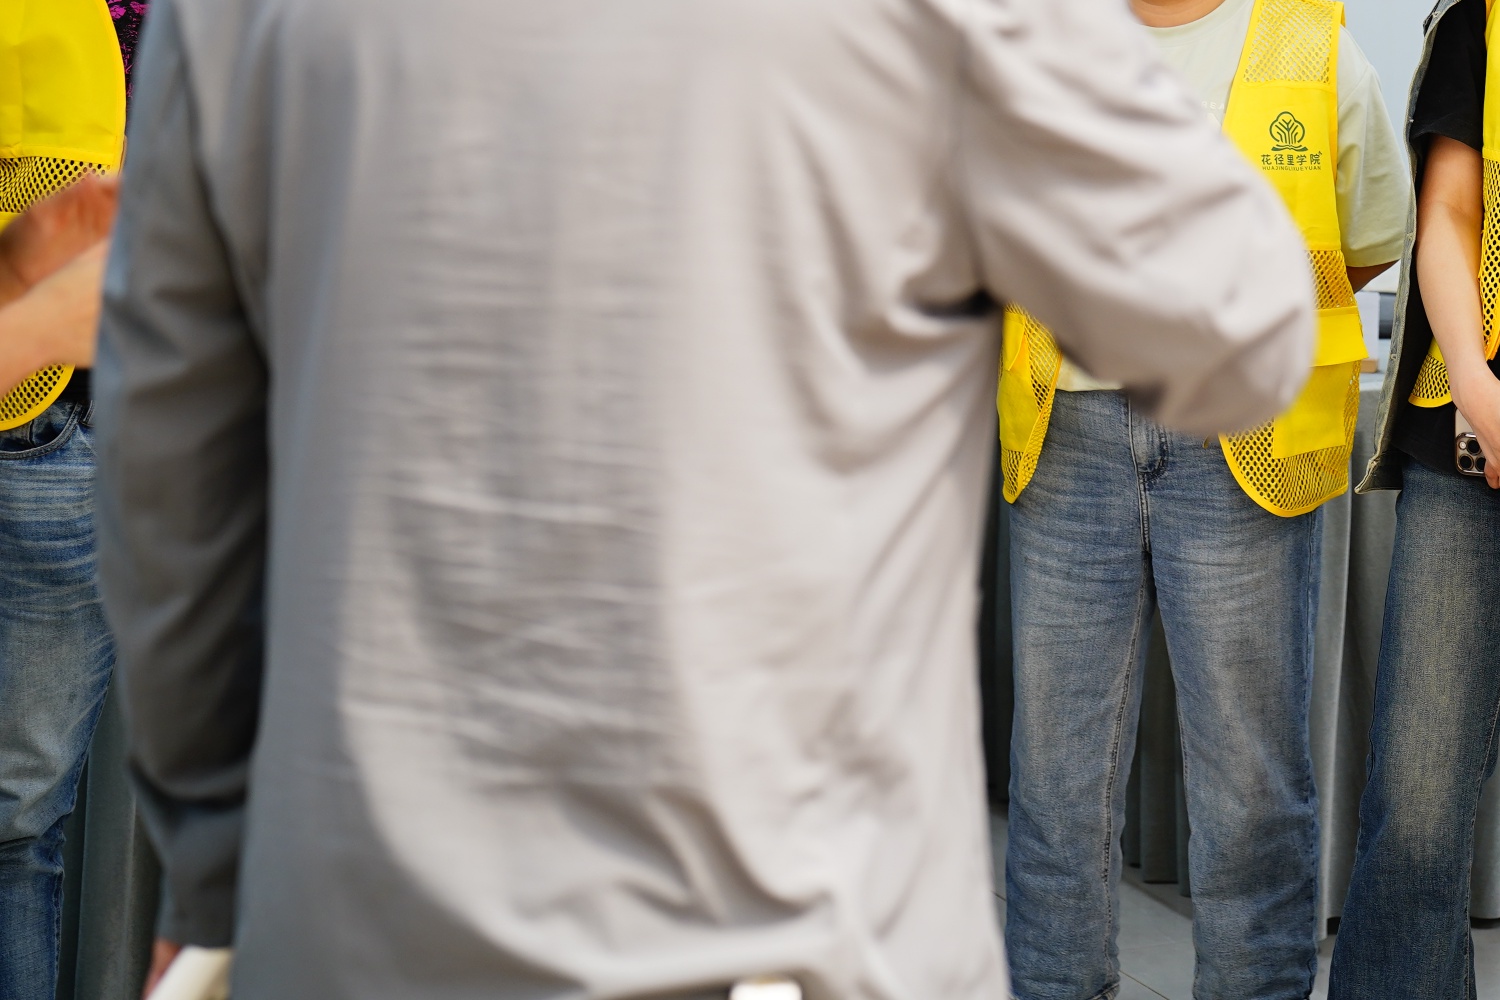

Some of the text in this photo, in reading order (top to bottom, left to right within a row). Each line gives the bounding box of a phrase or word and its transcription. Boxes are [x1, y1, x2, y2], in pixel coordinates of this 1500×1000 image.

[1261, 153, 1321, 166] 花径里学院
